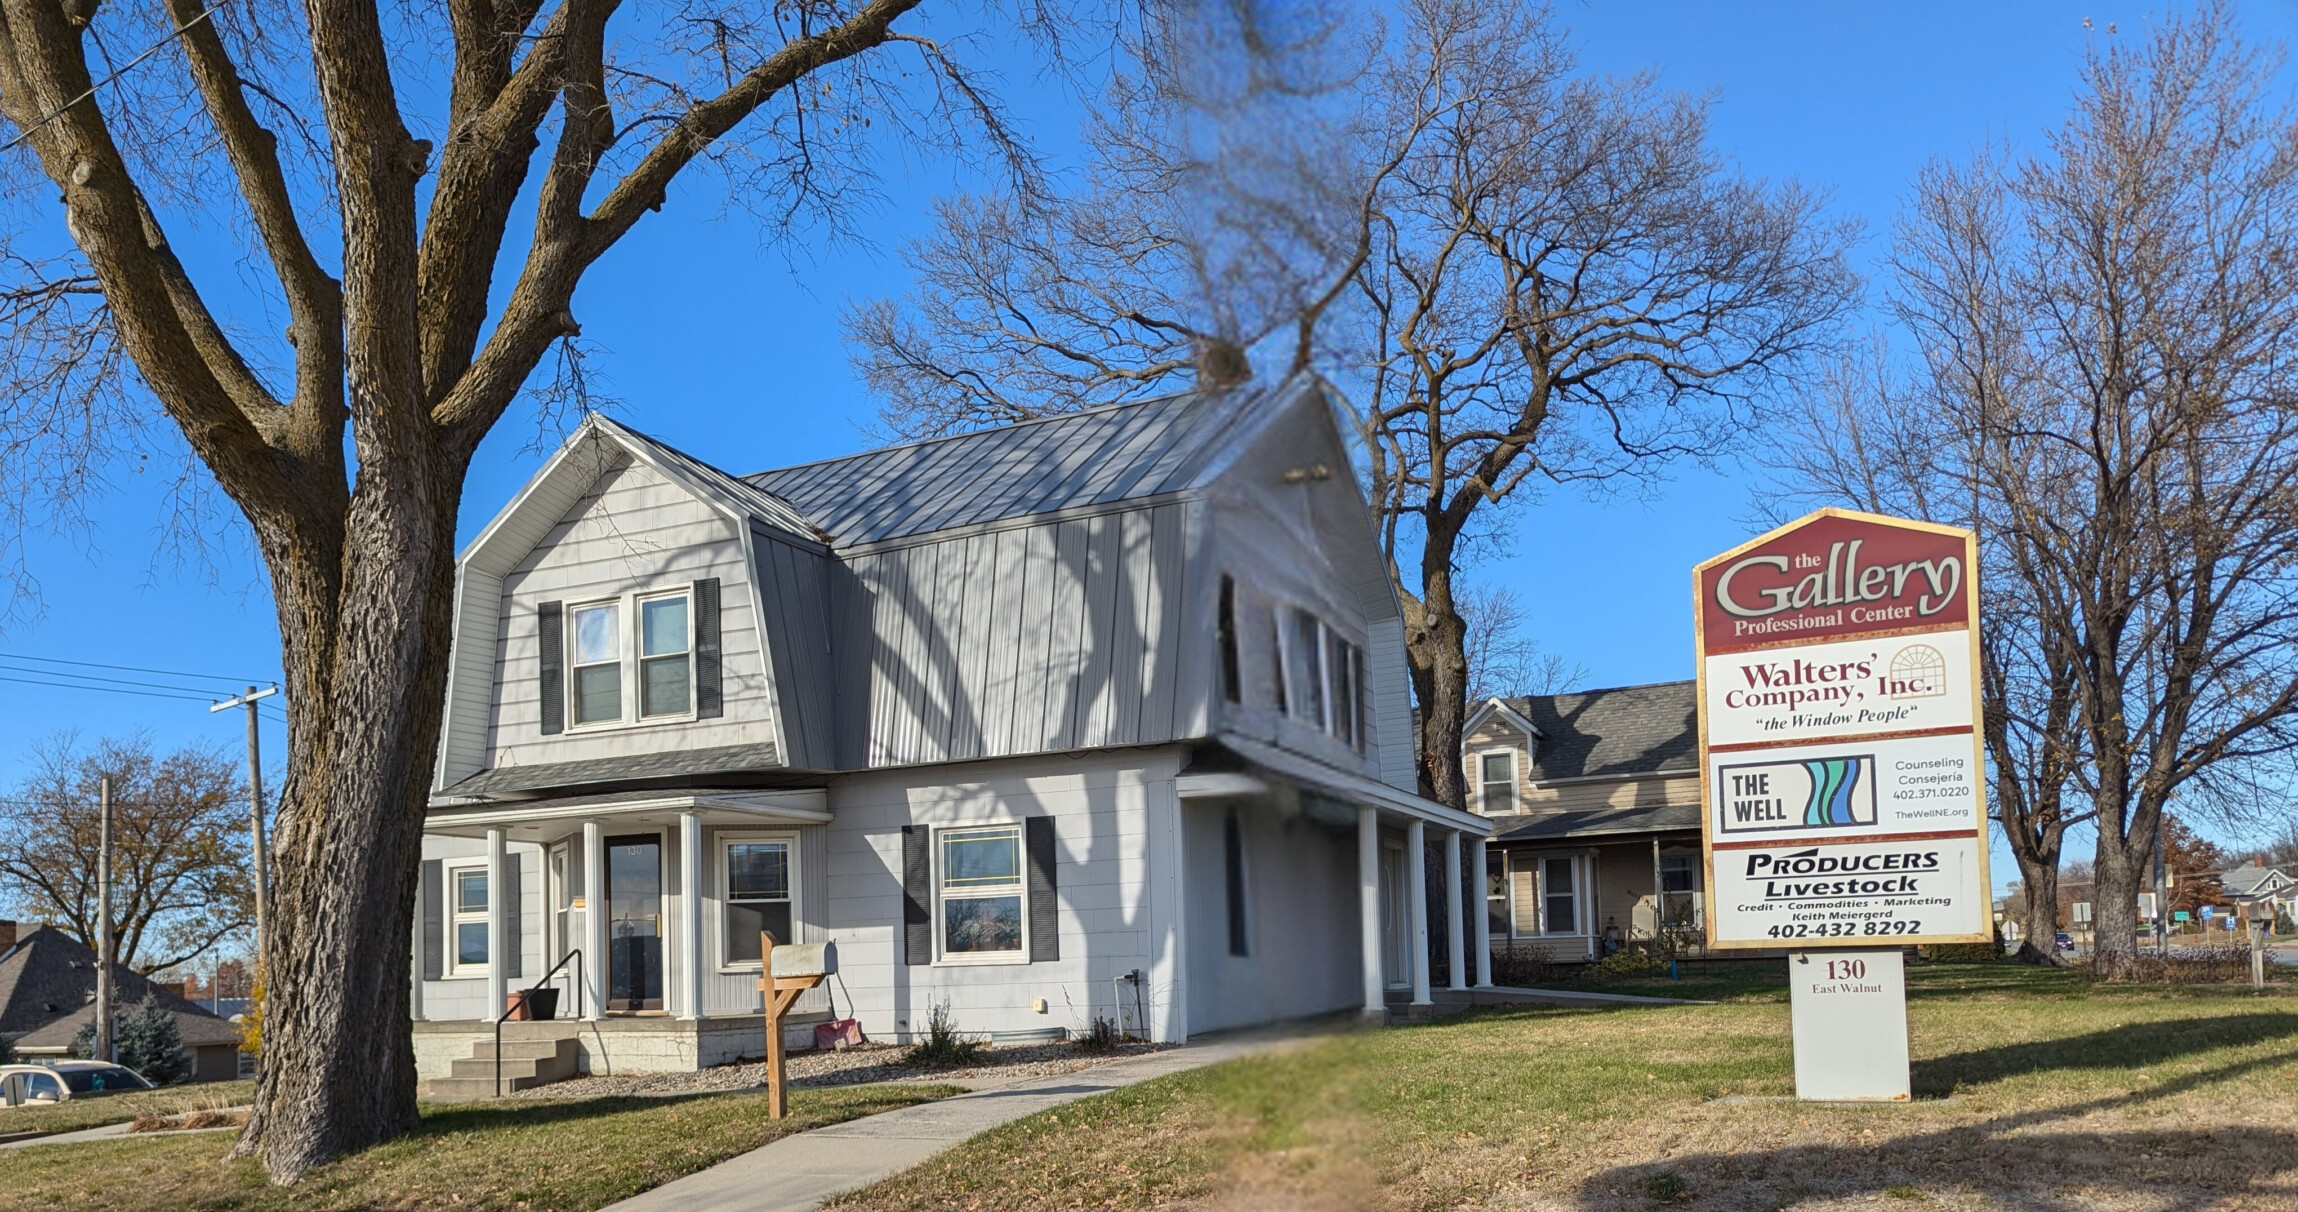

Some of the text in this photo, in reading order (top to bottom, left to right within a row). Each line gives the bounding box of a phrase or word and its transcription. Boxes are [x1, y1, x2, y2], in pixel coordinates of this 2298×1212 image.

[1795, 553, 1821, 568] the
[1715, 539, 1961, 617] Gallery
[1734, 606, 1913, 636] Professional Center
[1726, 676, 1932, 711] Company, Inc.
[1792, 713, 1853, 728] Window
[1895, 758, 1964, 771] Counseling
[1732, 774, 1769, 796] THE
[1898, 772, 1963, 786] Consejería
[1893, 786, 1969, 800] 402.371.0220
[1734, 799, 1787, 822] WELL
[1895, 808, 1968, 820] TheWellNE.org
[627, 846, 642, 856] 130
[1737, 897, 1951, 912] Credit Commodities Marketing
[1792, 910, 1893, 921] Keith Meiergerd
[1768, 920, 1921, 938] 402-432 8292
[1826, 959, 1866, 980] 130
[1812, 983, 1882, 994] East Walnut
